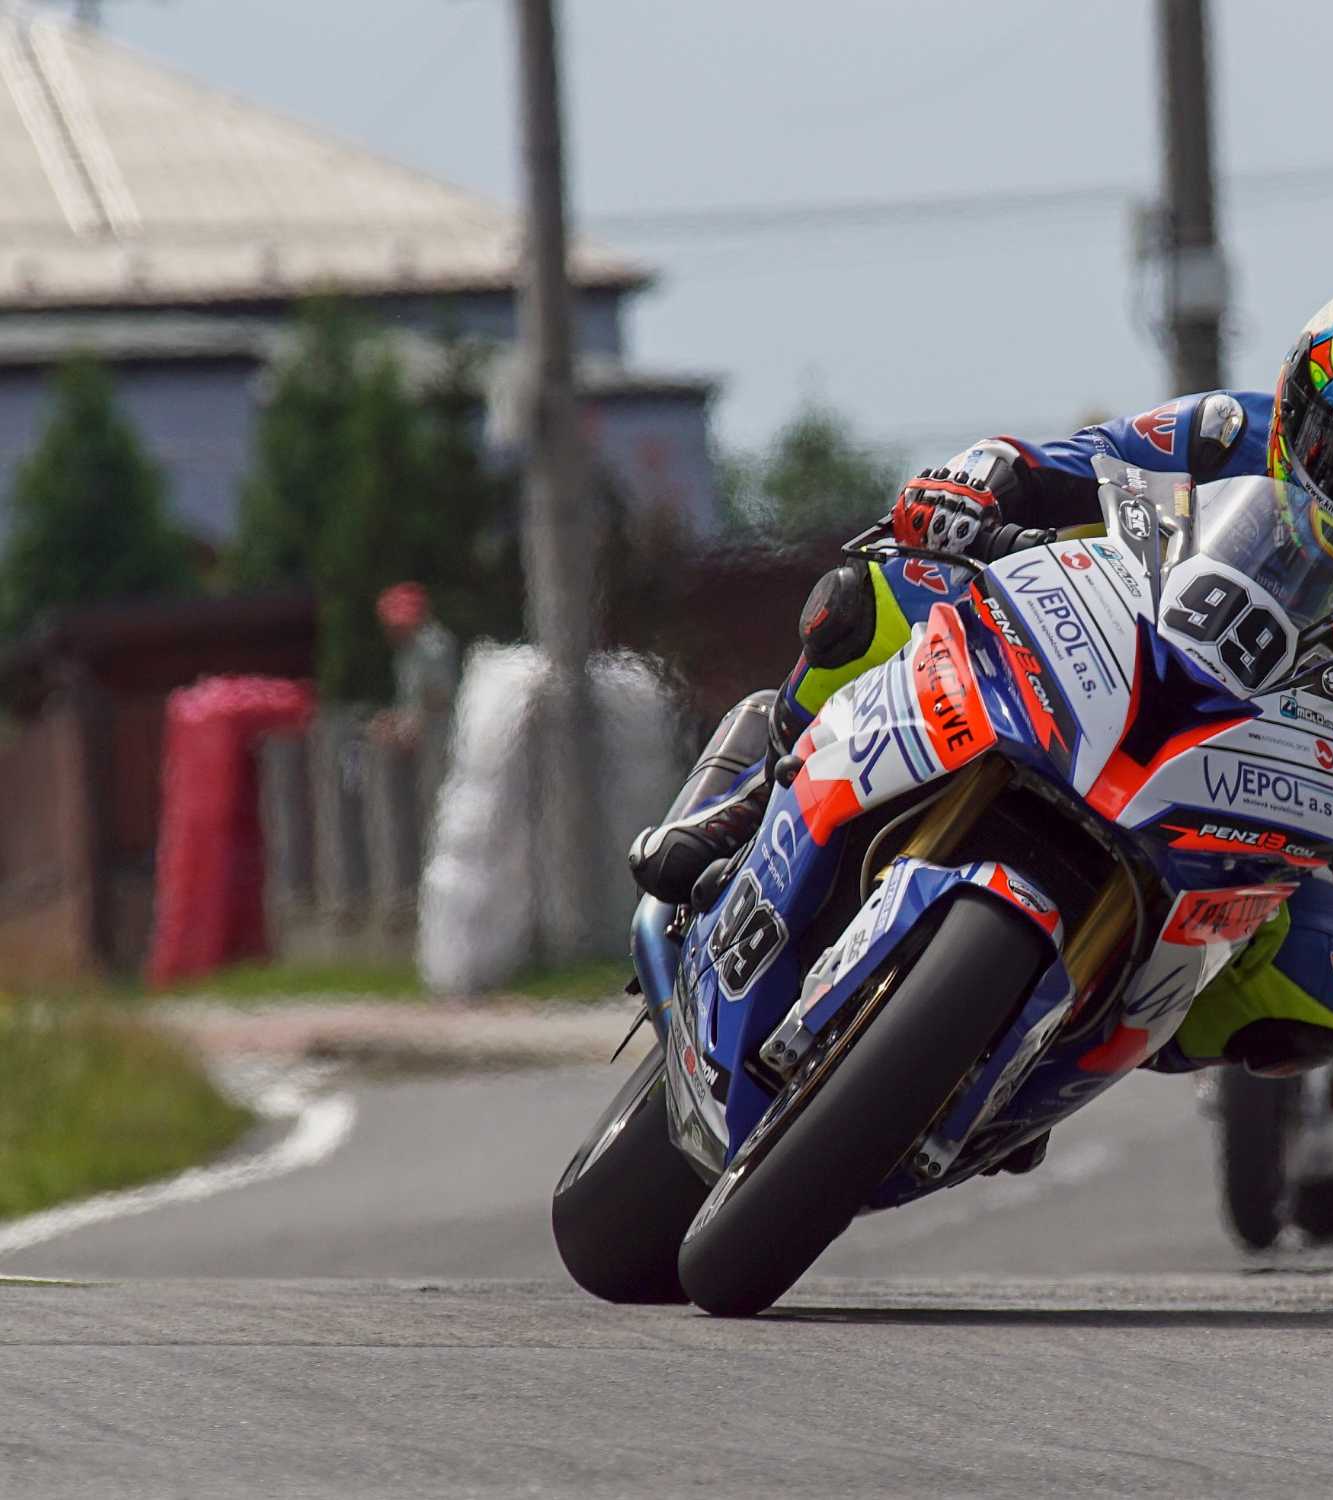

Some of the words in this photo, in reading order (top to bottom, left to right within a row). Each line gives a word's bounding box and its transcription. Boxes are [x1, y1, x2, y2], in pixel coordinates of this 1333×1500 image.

[1162, 573, 1287, 690] 99
[1204, 755, 1304, 806] WEPOL
[709, 870, 788, 1000] 99
